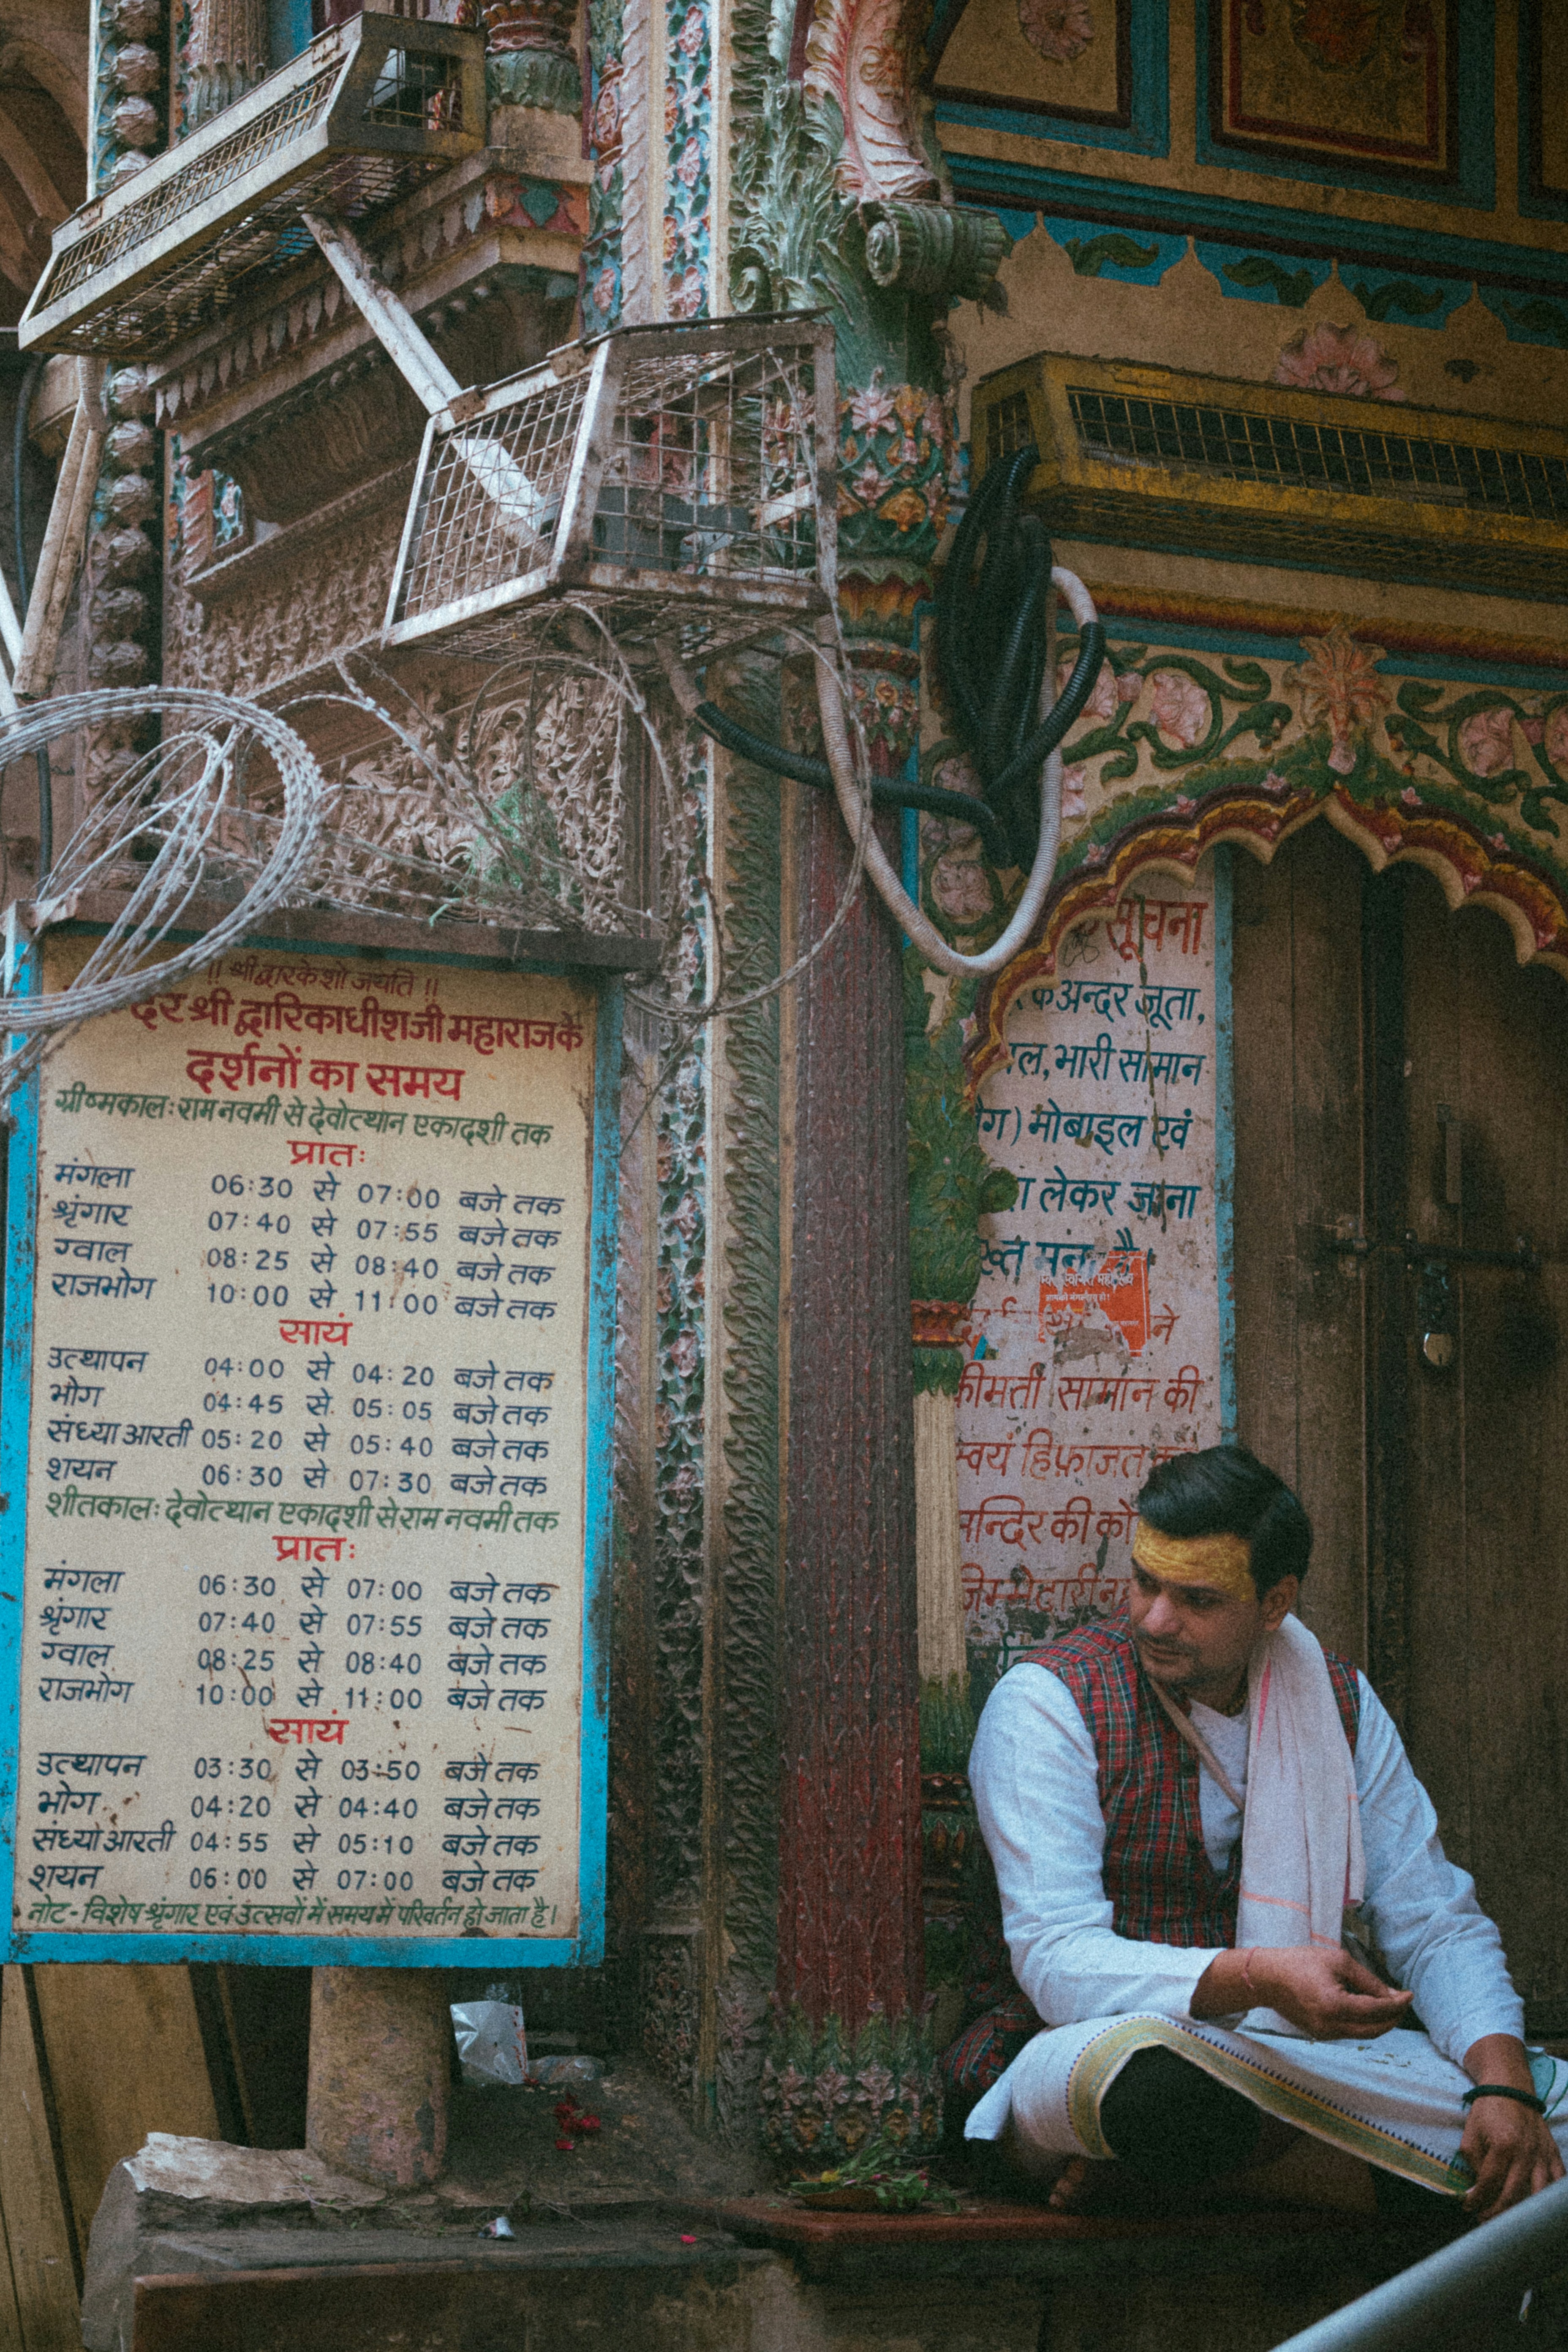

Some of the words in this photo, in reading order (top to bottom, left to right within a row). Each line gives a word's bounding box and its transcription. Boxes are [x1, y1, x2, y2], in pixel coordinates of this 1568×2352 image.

[1107, 898, 1209, 963] सूचना
[352, 969, 416, 997] जयति
[189, 987, 234, 1025] श्री
[557, 1011, 583, 1051] के
[1057, 980, 1134, 1023] अन्दर
[1135, 985, 1205, 1031] जूता,
[187, 1043, 301, 1094] दर्शनों
[310, 1060, 359, 1092] का
[367, 1064, 465, 1100] समय
[1056, 1033, 1116, 1081] भारी
[1120, 1049, 1206, 1086] सामान
[283, 1095, 307, 1127] से
[308, 1096, 408, 1135] देवोत्थान
[414, 1112, 509, 1146] एकादशी
[511, 1122, 553, 1145] तक
[1029, 1099, 1148, 1156] मोबाइल
[287, 1141, 364, 1167] प्रातः
[56, 1158, 135, 1188] मंगला
[212, 1175, 292, 1198] 06:30
[314, 1171, 340, 1201] से
[358, 1184, 439, 1209] 07:00
[459, 1184, 507, 1212] बजे
[514, 1195, 564, 1215] तक
[1040, 1165, 1122, 1216] लेकर
[1127, 1181, 1202, 1219] जाना
[209, 1211, 290, 1233] 07:40
[312, 1209, 338, 1236] से
[357, 1220, 437, 1242] 07:55
[459, 1218, 508, 1246] बजे
[512, 1229, 561, 1248] तक
[55, 1239, 132, 1263] ग्वाल
[207, 1248, 288, 1270] 08:25
[311, 1244, 337, 1273] से
[356, 1255, 438, 1279] 08:40
[457, 1253, 504, 1281] बजे
[508, 1265, 555, 1285] तक
[52, 1267, 157, 1299] राजभोग
[209, 1284, 288, 1307] 10:00
[310, 1279, 337, 1309] से
[356, 1290, 437, 1315] 11:00
[455, 1289, 504, 1317] बजे
[506, 1300, 557, 1320] तक
[279, 1313, 353, 1346] सायं
[49, 1348, 149, 1372] उत्थापन
[205, 1358, 283, 1378] 04:00
[307, 1352, 335, 1380] से
[353, 1364, 434, 1386] 04:20
[455, 1360, 499, 1389] बजे
[504, 1371, 555, 1392] तक
[1058, 1376, 1161, 1412] सामान
[1164, 1365, 1206, 1413] की
[51, 1376, 103, 1407] भोग
[204, 1393, 283, 1414] 04:45
[307, 1388, 332, 1416] से
[353, 1398, 431, 1420] 05:05
[454, 1395, 499, 1424] बजे
[503, 1406, 551, 1426] तक
[48, 1414, 121, 1444] संध्या
[122, 1418, 193, 1447] आरती
[202, 1429, 282, 1449] 05:20
[304, 1424, 330, 1452] से
[351, 1435, 432, 1456] 05:40
[452, 1430, 499, 1458] बजे
[503, 1440, 548, 1461] तक
[47, 1458, 117, 1481] शयन
[203, 1465, 282, 1487] 06:30
[304, 1459, 329, 1488] से
[350, 1470, 430, 1494] 07:30
[451, 1466, 496, 1494] बजे
[500, 1476, 547, 1497] तक
[165, 1486, 273, 1528] देवोत्थान
[278, 1492, 375, 1533] एकादशी
[376, 1495, 399, 1530] से
[513, 1511, 559, 1534] तक
[1051, 1496, 1096, 1545] की
[272, 1536, 354, 1562] प्रातः
[44, 1560, 125, 1593] मंगला
[199, 1575, 275, 1596] 06:30
[301, 1567, 329, 1598] से
[348, 1579, 422, 1601] 07:00
[449, 1573, 500, 1603] बजे
[503, 1583, 551, 1604] तक
[199, 1612, 275, 1633] 07:40
[299, 1604, 327, 1635] से
[347, 1614, 422, 1636] 07:55
[449, 1608, 497, 1639] बजे
[502, 1618, 550, 1639] तक
[42, 1643, 114, 1668] ग्वाल
[196, 1648, 274, 1674] 08:25
[298, 1641, 324, 1673] से
[346, 1652, 421, 1674] 08:40
[448, 1644, 494, 1676] बजे
[500, 1654, 546, 1675] तक
[39, 1672, 134, 1702] राजभोग
[197, 1681, 275, 1706] 10:00
[297, 1678, 324, 1707] से
[346, 1688, 422, 1710] 11:00
[447, 1680, 494, 1710] बजे
[498, 1690, 547, 1711] तक
[269, 1710, 349, 1744] सायं
[37, 1753, 147, 1776] उत्थापन
[194, 1758, 272, 1780] 03:30
[296, 1749, 322, 1781] से
[342, 1760, 420, 1781] 03:50
[444, 1753, 492, 1782] बजे
[495, 1762, 540, 1782] तक
[38, 1780, 101, 1814] भोग
[191, 1795, 270, 1818] 04:20
[295, 1786, 322, 1818] से
[339, 1797, 417, 1818] 04:40
[444, 1788, 492, 1819] बजे
[495, 1798, 540, 1820] तक
[33, 1823, 104, 1851] संध्या
[103, 1820, 177, 1852] आरती
[191, 1832, 267, 1852] 04:55
[293, 1824, 321, 1854] से
[339, 1834, 413, 1854] 05:10
[442, 1825, 491, 1856] बजे
[494, 1835, 540, 1856] तक
[28, 1865, 104, 1891] शयन
[191, 1867, 266, 1889] 06:00
[293, 1860, 318, 1890] से
[338, 1870, 412, 1891] 07:00
[442, 1860, 489, 1892] बजे
[493, 1870, 539, 1891] तक
[82, 1895, 144, 1926] विशेष
[205, 1896, 236, 1926] एवं
[235, 1895, 307, 1927] उत्सवों
[306, 1896, 328, 1927] में
[328, 1906, 377, 1926] समय
[378, 1897, 396, 1925] में
[398, 1897, 465, 1927] परिवर्तन
[466, 1898, 486, 1930] हो
[485, 1906, 529, 1926] जाता
